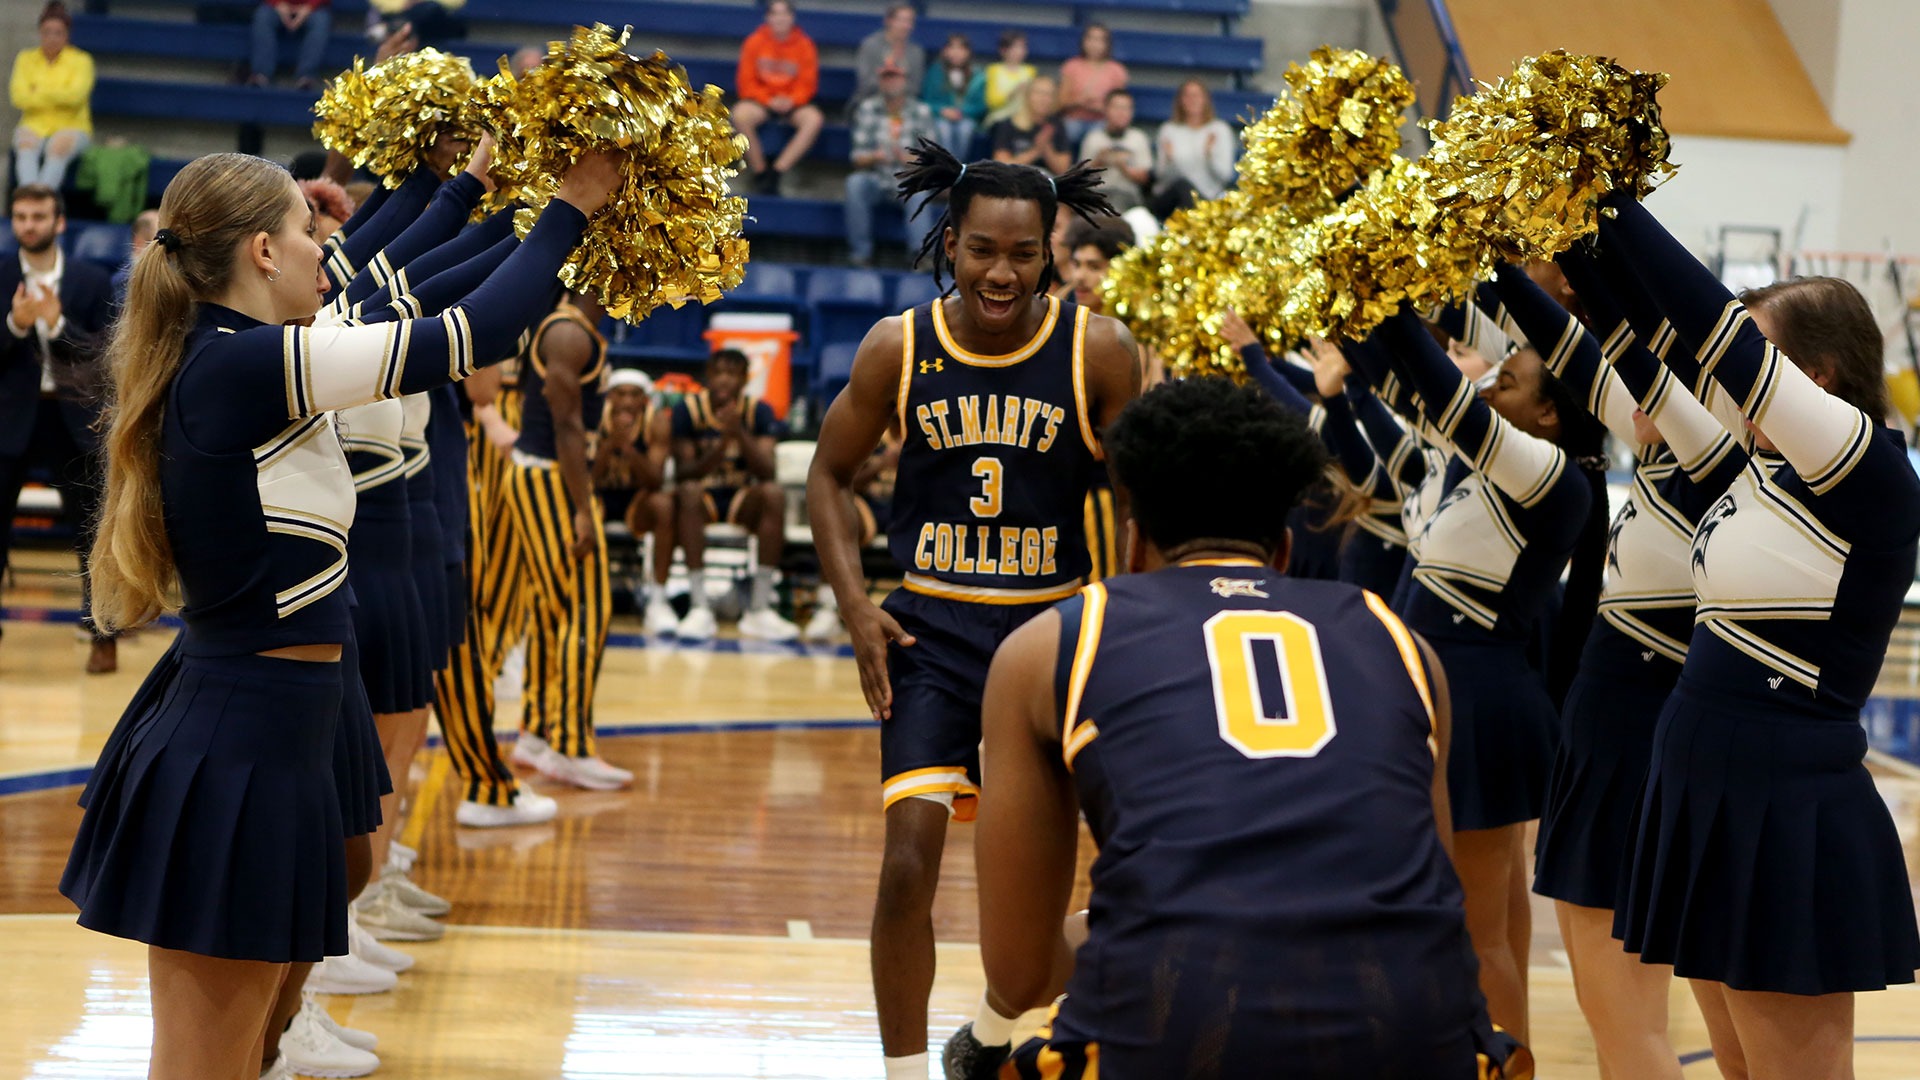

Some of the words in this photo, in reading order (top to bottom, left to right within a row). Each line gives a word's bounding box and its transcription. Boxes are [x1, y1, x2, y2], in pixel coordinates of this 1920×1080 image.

[916, 394, 1065, 453] ST.MARY'S
[970, 456, 1003, 518] 3
[915, 522, 1058, 576] COLLEGE
[1203, 609, 1338, 759] 0
